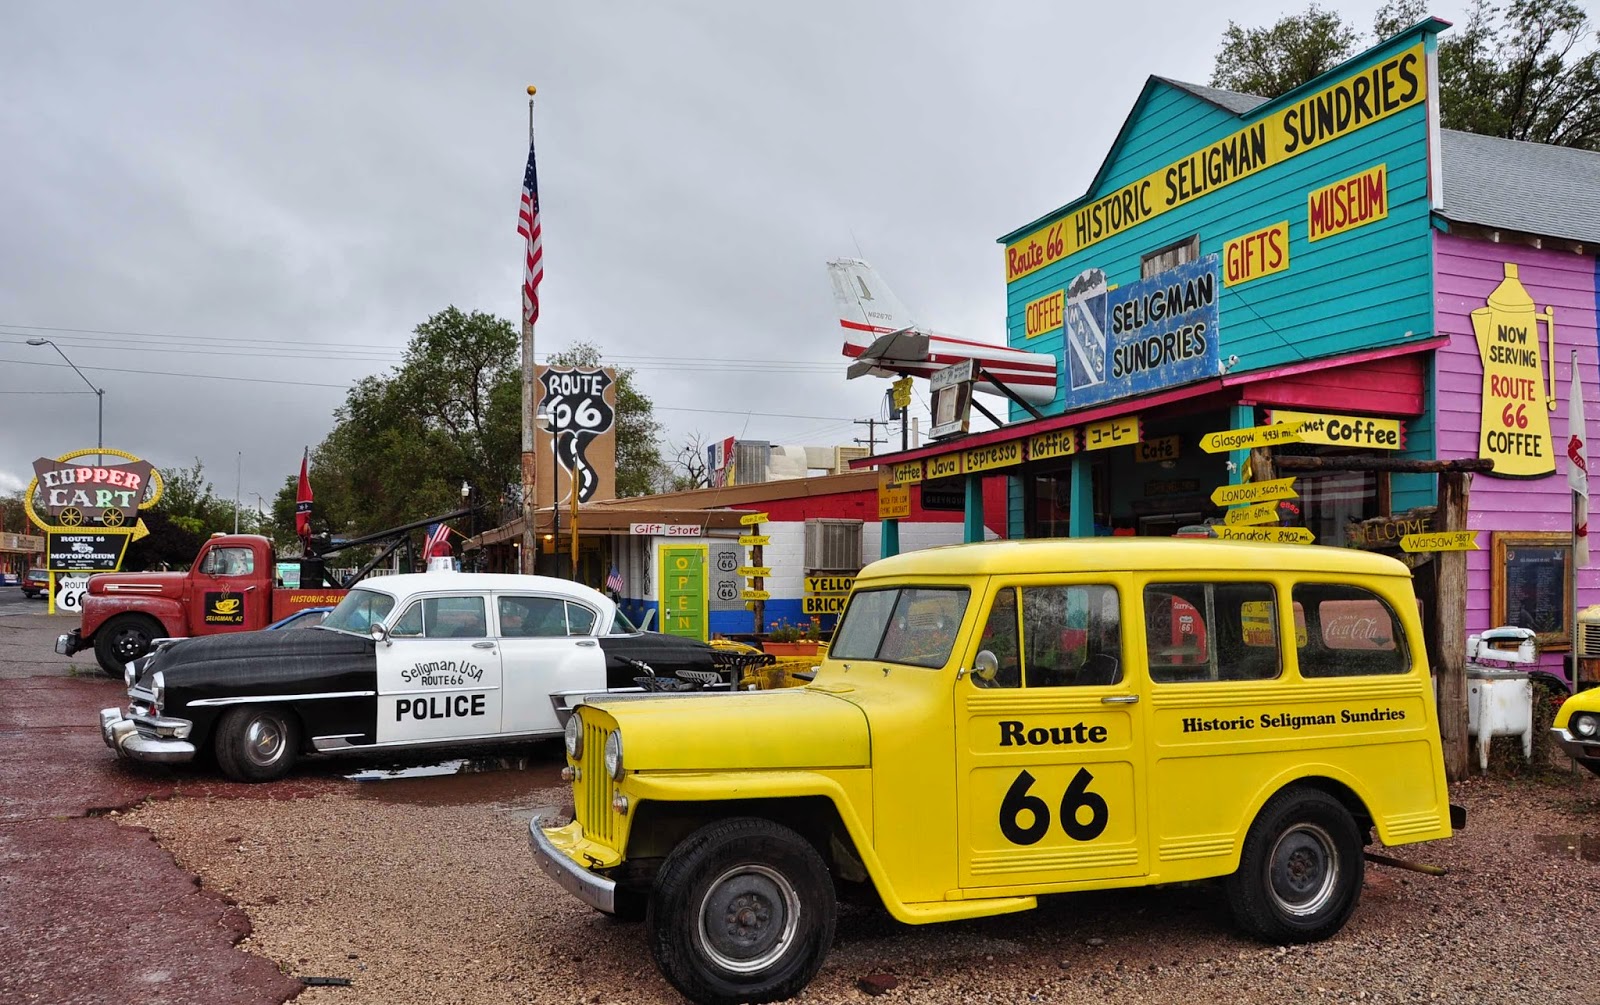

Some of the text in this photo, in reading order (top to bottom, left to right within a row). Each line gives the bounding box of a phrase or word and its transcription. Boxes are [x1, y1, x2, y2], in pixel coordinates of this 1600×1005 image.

[1008, 53, 1418, 278] Route 66 HISTORIC SELIGMAN SUNDRIES
[1310, 170, 1384, 238] MUSEUM
[1227, 228, 1283, 282] GIFTS
[1026, 293, 1062, 335] COFFEE
[1112, 272, 1214, 335] SELIGMAN
[1069, 308, 1103, 373] MALTS
[1498, 324, 1527, 345] NOW
[1112, 323, 1206, 379] SUNDRIES
[1489, 345, 1537, 369] SERVING
[549, 374, 603, 396] ROUTE
[1491, 374, 1536, 401] ROUTE
[546, 395, 602, 428] 66
[1502, 403, 1528, 429] 66
[1092, 423, 1131, 444] コーヒー
[1211, 431, 1255, 449] Glasgow
[1326, 419, 1397, 445] Coffee
[1032, 432, 1071, 458] Koffie
[1142, 439, 1173, 460] Café
[1487, 430, 1542, 457] COFFEE
[932, 459, 955, 476] Java
[967, 444, 1017, 470] Espresso
[42, 467, 141, 490] COPPER
[894, 466, 920, 482] Kaffee
[49, 488, 137, 508] CART
[926, 495, 965, 504] GREYHOU
[1222, 487, 1257, 502] LONDON
[1231, 510, 1249, 524] Berlin
[60, 535, 94, 543] ROUTE
[634, 524, 700, 535] Gift Store
[1408, 536, 1453, 549] Warsaw
[721, 560, 733, 569] 66
[64, 581, 88, 589] ROUT
[676, 557, 690, 629] OPEN
[721, 589, 733, 597] 66
[290, 595, 324, 603] HISTORIC
[807, 597, 846, 612] BRICK
[205, 615, 234, 623] SELIGMAN,
[1181, 623, 1191, 632] 66
[421, 675, 464, 686] ROUTE 66
[460, 660, 483, 682] USA
[396, 694, 486, 722] POLICE
[1182, 707, 1406, 733] Historic Seligman Sundries
[998, 720, 1108, 747] Route
[999, 767, 1109, 846] 66
